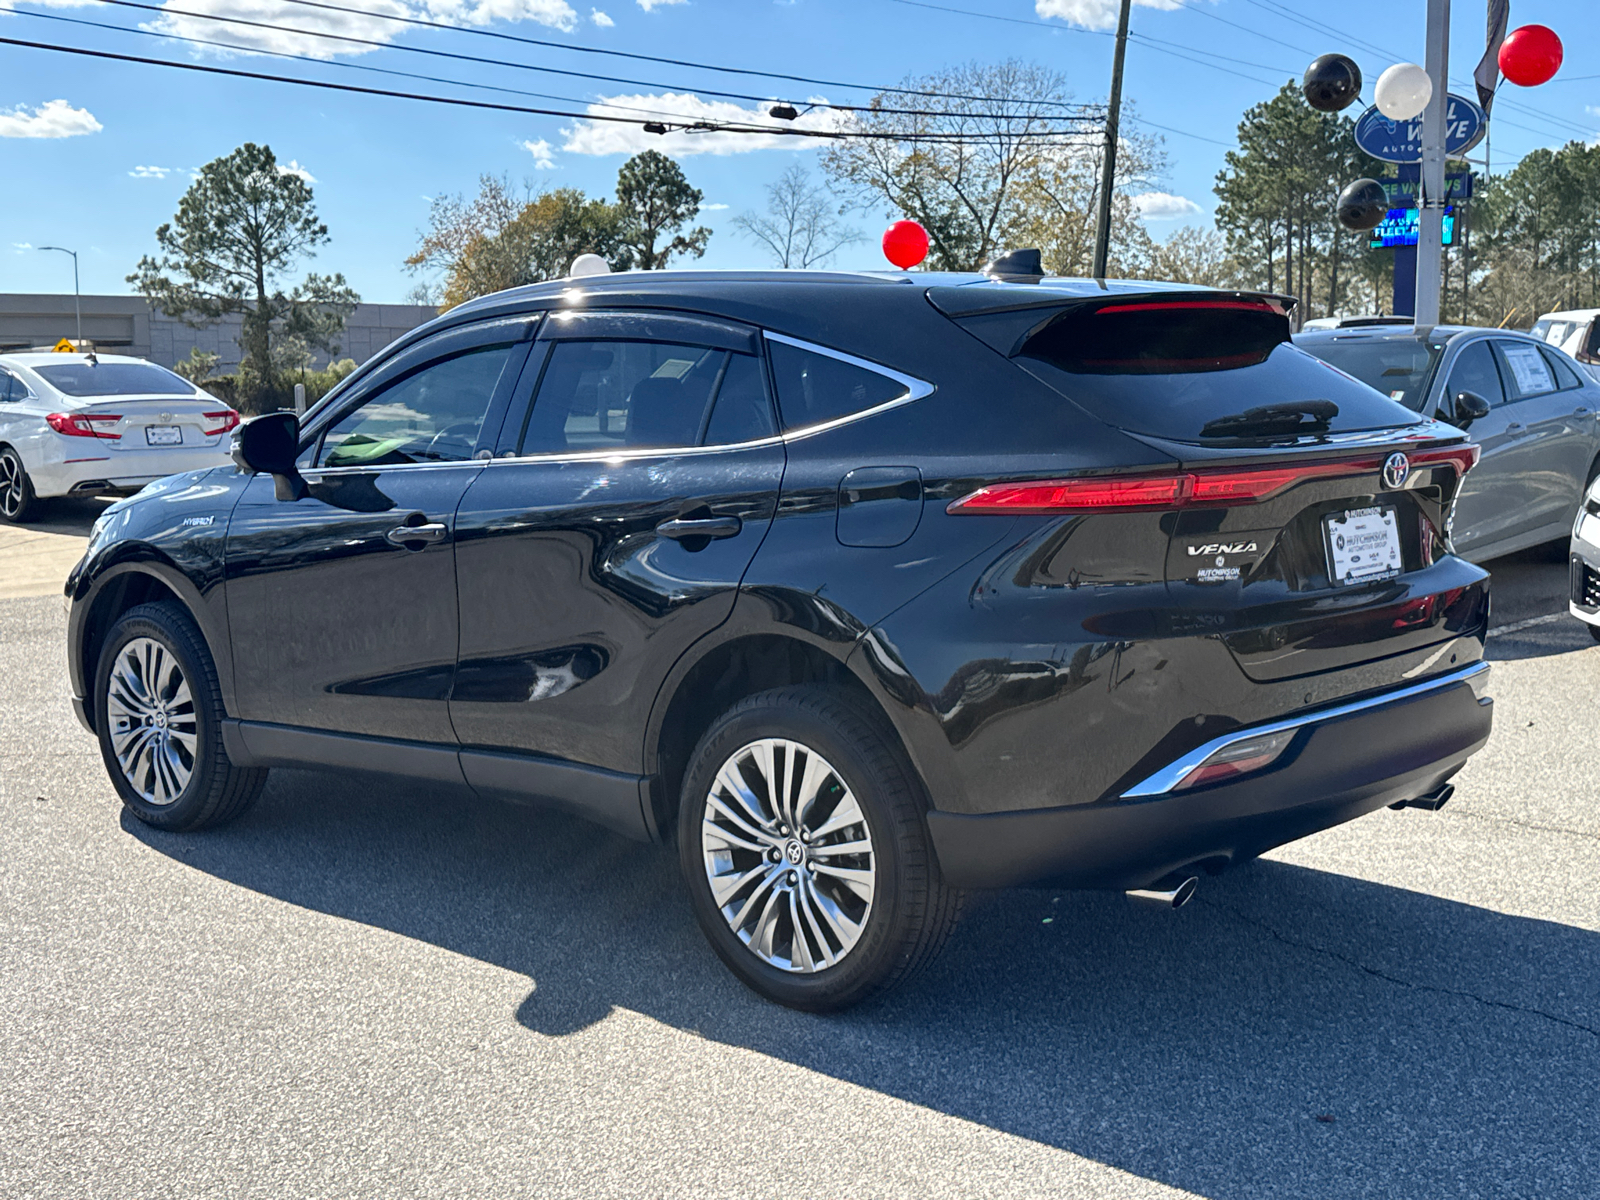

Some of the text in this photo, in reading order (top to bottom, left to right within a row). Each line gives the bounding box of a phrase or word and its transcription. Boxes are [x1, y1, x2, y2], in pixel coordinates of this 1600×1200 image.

[1382, 144, 1414, 153] AUTO
[1346, 532, 1388, 546] HUTCHINSON
[1188, 542, 1257, 556] VENZA
[1197, 567, 1241, 577] HUTCHINSON
[126, 620, 170, 641] YOKOHAMA
